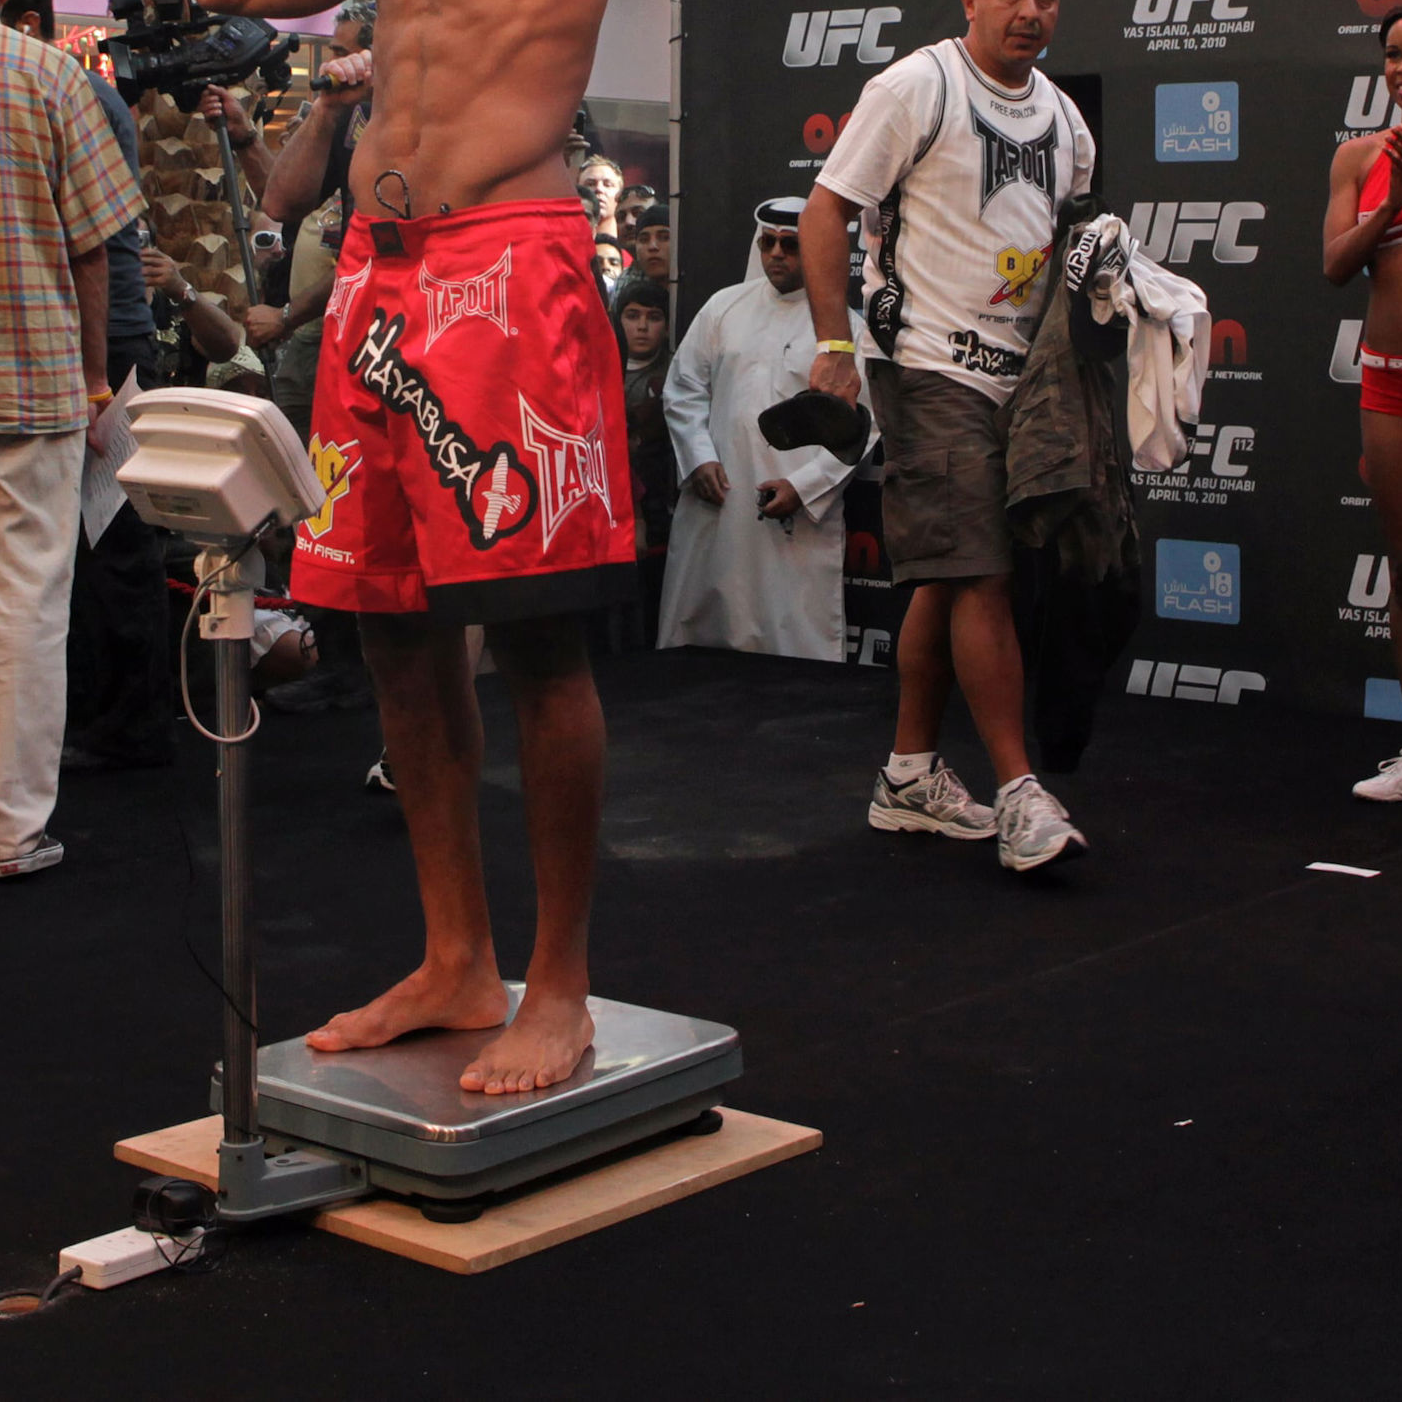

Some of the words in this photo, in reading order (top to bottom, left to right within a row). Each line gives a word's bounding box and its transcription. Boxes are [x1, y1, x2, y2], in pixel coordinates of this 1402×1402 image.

[782, 6, 902, 68] UFC
[1123, 26, 1144, 38] YAS
[1146, 23, 1190, 37] ISLAND,
[1192, 21, 1217, 34] ABU
[1219, 20, 1255, 33] DHABI
[1338, 24, 1368, 34] ORBIT
[1147, 38, 1180, 51] APRIL
[1183, 37, 1198, 50] 10,
[1200, 36, 1226, 49] 2010
[1163, 138, 1231, 152] FLASH
[1127, 201, 1266, 264] UFC
[1215, 370, 1263, 381] NETWORK
[355, 319, 482, 501] HAYABUSA
[1132, 424, 1255, 478] FC
[1234, 439, 1254, 451] 112
[1129, 473, 1144, 485] AS
[1146, 474, 1191, 489] ISLAND,
[1193, 476, 1218, 490] ABU
[1220, 478, 1256, 492] DHABI
[1148, 489, 1181, 502] APRIL
[1184, 491, 1199, 503] 10,
[1202, 492, 1227, 504] 2010
[1341, 496, 1372, 506] ORBIT
[314, 544, 355, 565] FIRST.
[1164, 595, 1232, 614] FLASH
[1338, 608, 1361, 621] YAS
[1363, 610, 1390, 624] ISLA
[1364, 625, 1392, 639] APR
